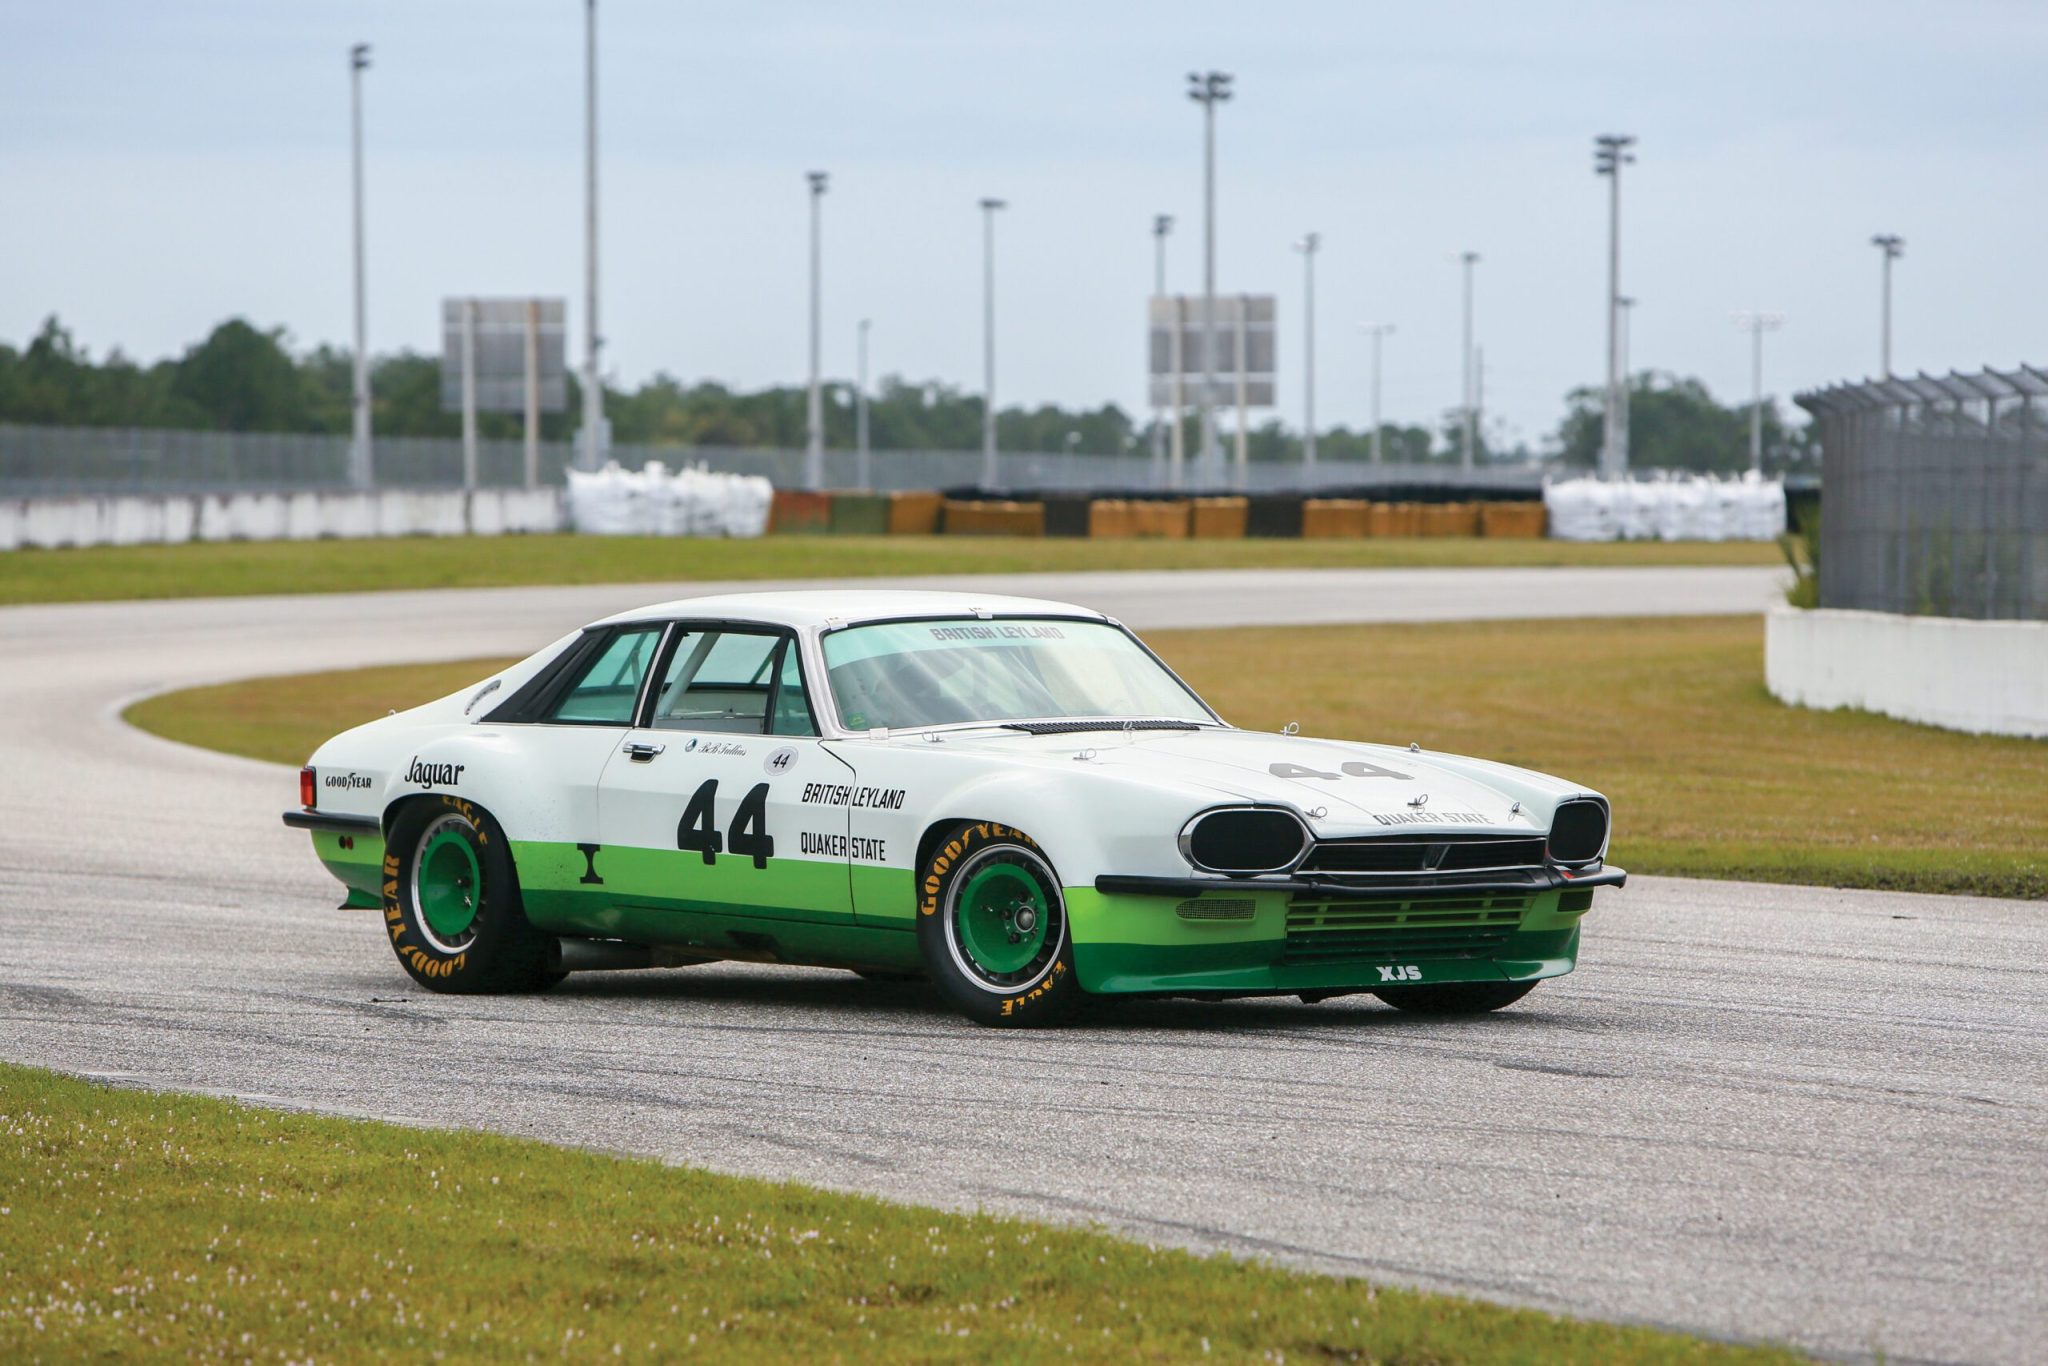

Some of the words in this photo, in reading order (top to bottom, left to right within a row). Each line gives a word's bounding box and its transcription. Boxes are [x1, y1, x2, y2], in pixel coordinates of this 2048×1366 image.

[929, 626, 997, 640] BRITISH
[996, 626, 1065, 640] LEYLAND
[772, 753, 791, 768] 44
[404, 755, 465, 789] Jaguar
[1269, 761, 1416, 781] 44
[325, 772, 372, 791] GOODYEAR
[801, 783, 852, 806] BRITISH
[851, 786, 906, 810] LEYLAND
[677, 778, 775, 869] 44
[1373, 812, 1444, 826] QUAKER
[1441, 812, 1496, 825] STATE
[801, 831, 847, 857] QUAKER
[851, 837, 886, 861] STATE
[1375, 965, 1423, 982] XJS
